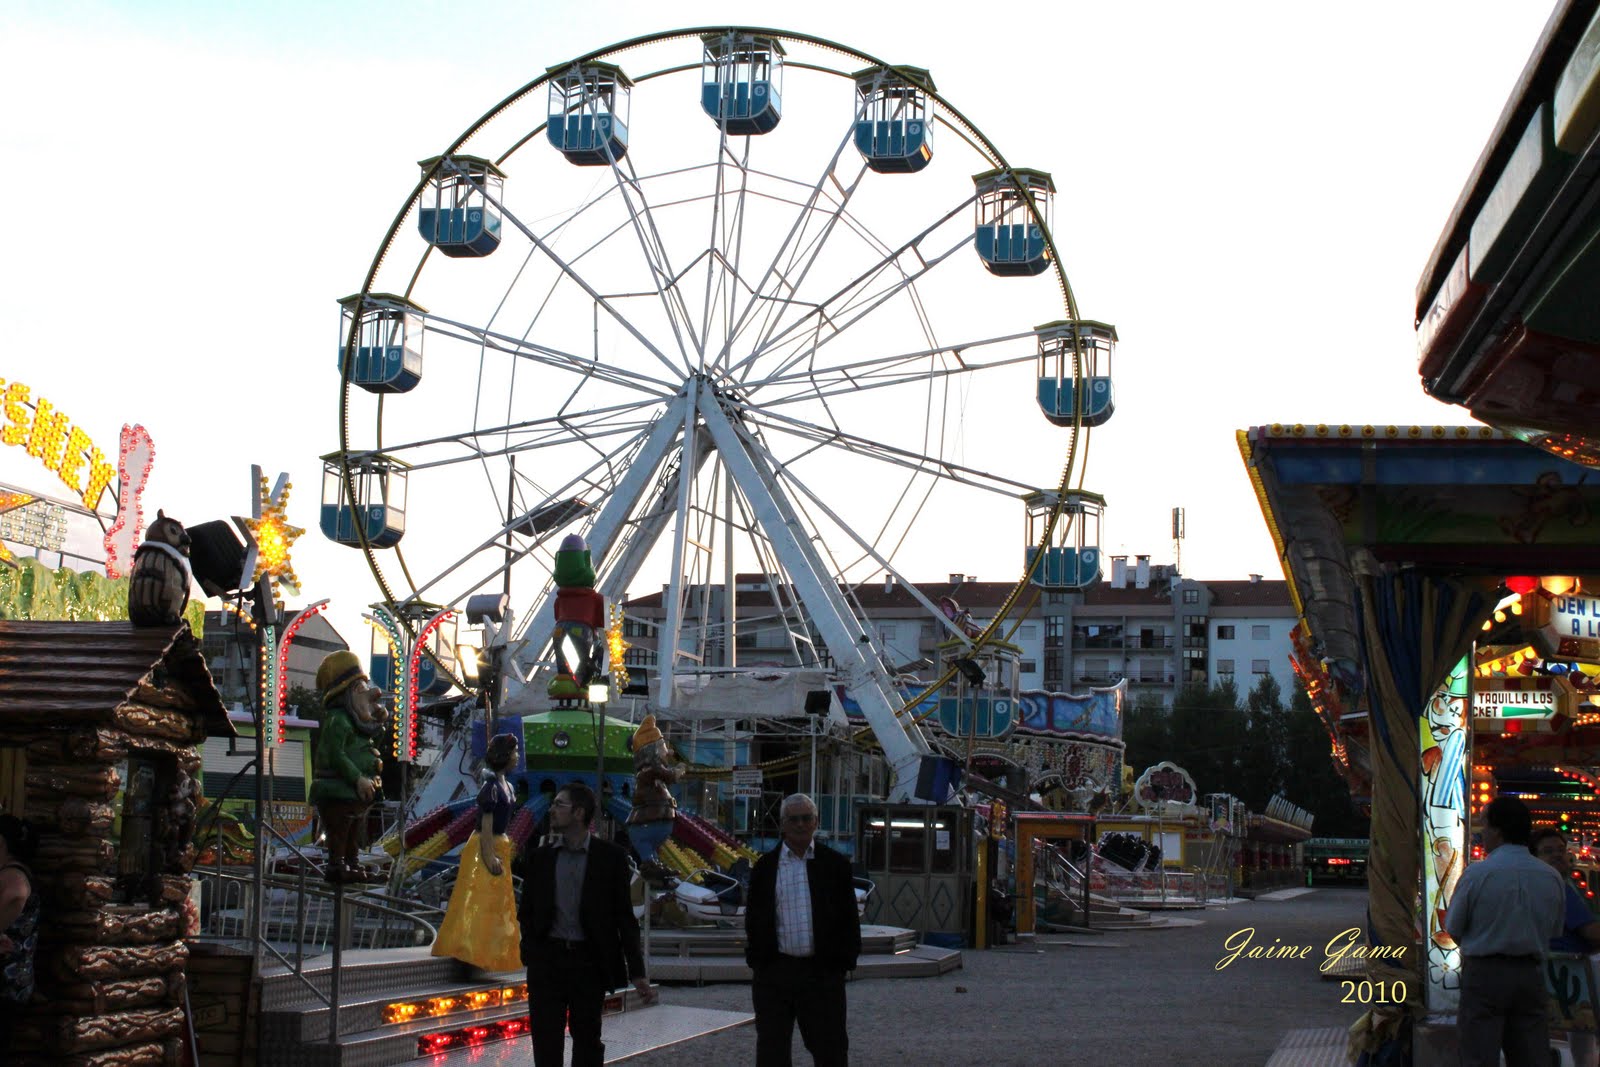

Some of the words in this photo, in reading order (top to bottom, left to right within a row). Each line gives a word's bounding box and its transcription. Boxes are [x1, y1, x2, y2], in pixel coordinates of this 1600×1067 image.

[1571, 618, 1580, 636] A
[1478, 692, 1529, 704] TAQUILLA
[1533, 692, 1553, 704] LOS
